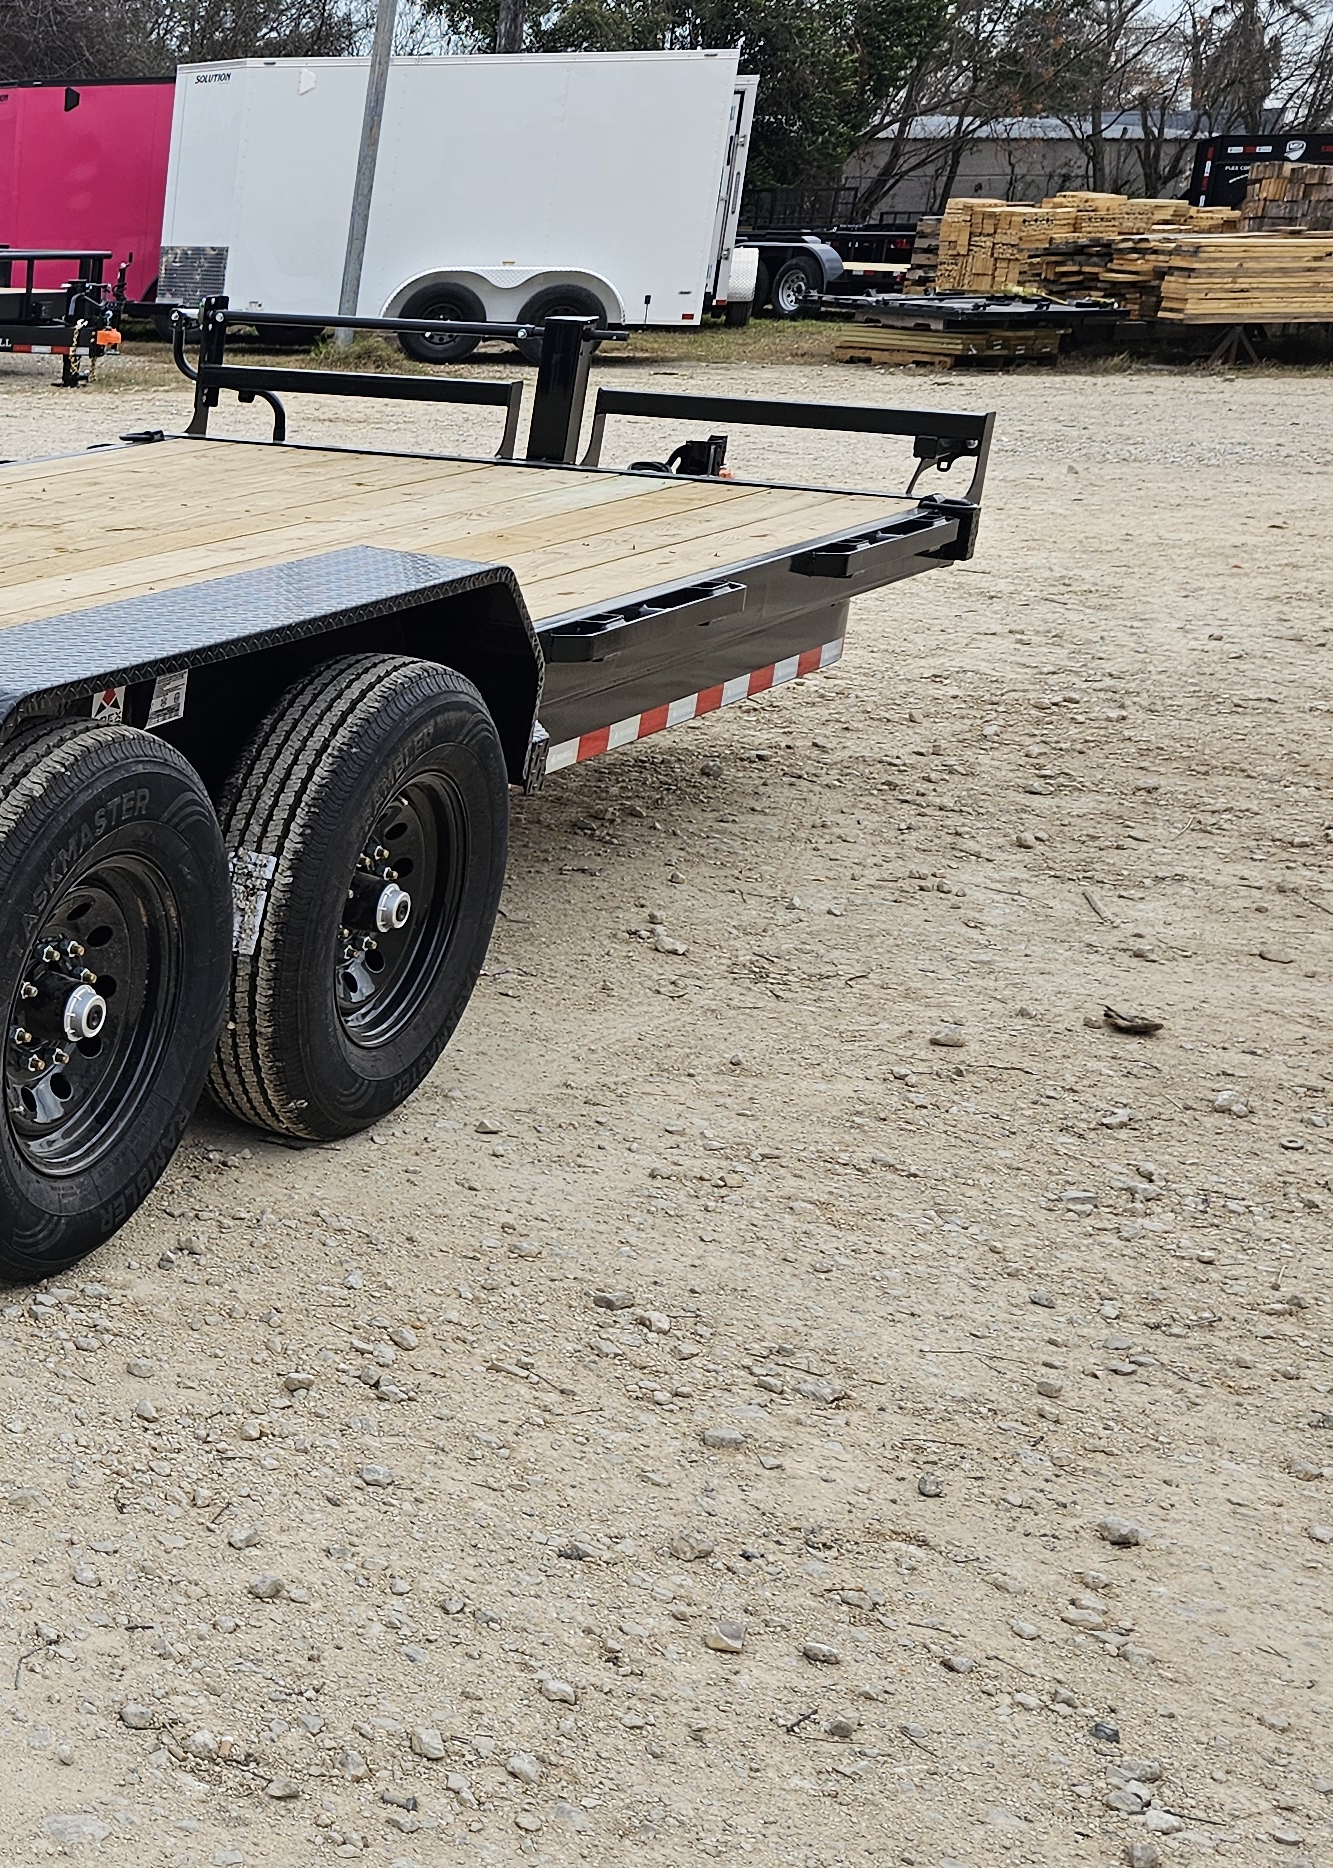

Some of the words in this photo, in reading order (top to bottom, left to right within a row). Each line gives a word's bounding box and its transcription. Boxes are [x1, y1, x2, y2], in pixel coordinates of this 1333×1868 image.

[195, 73, 232, 84] SOLUTION
[5, 787, 151, 959] TASKMASTER
[100, 1103, 192, 1233] RAMBLER
